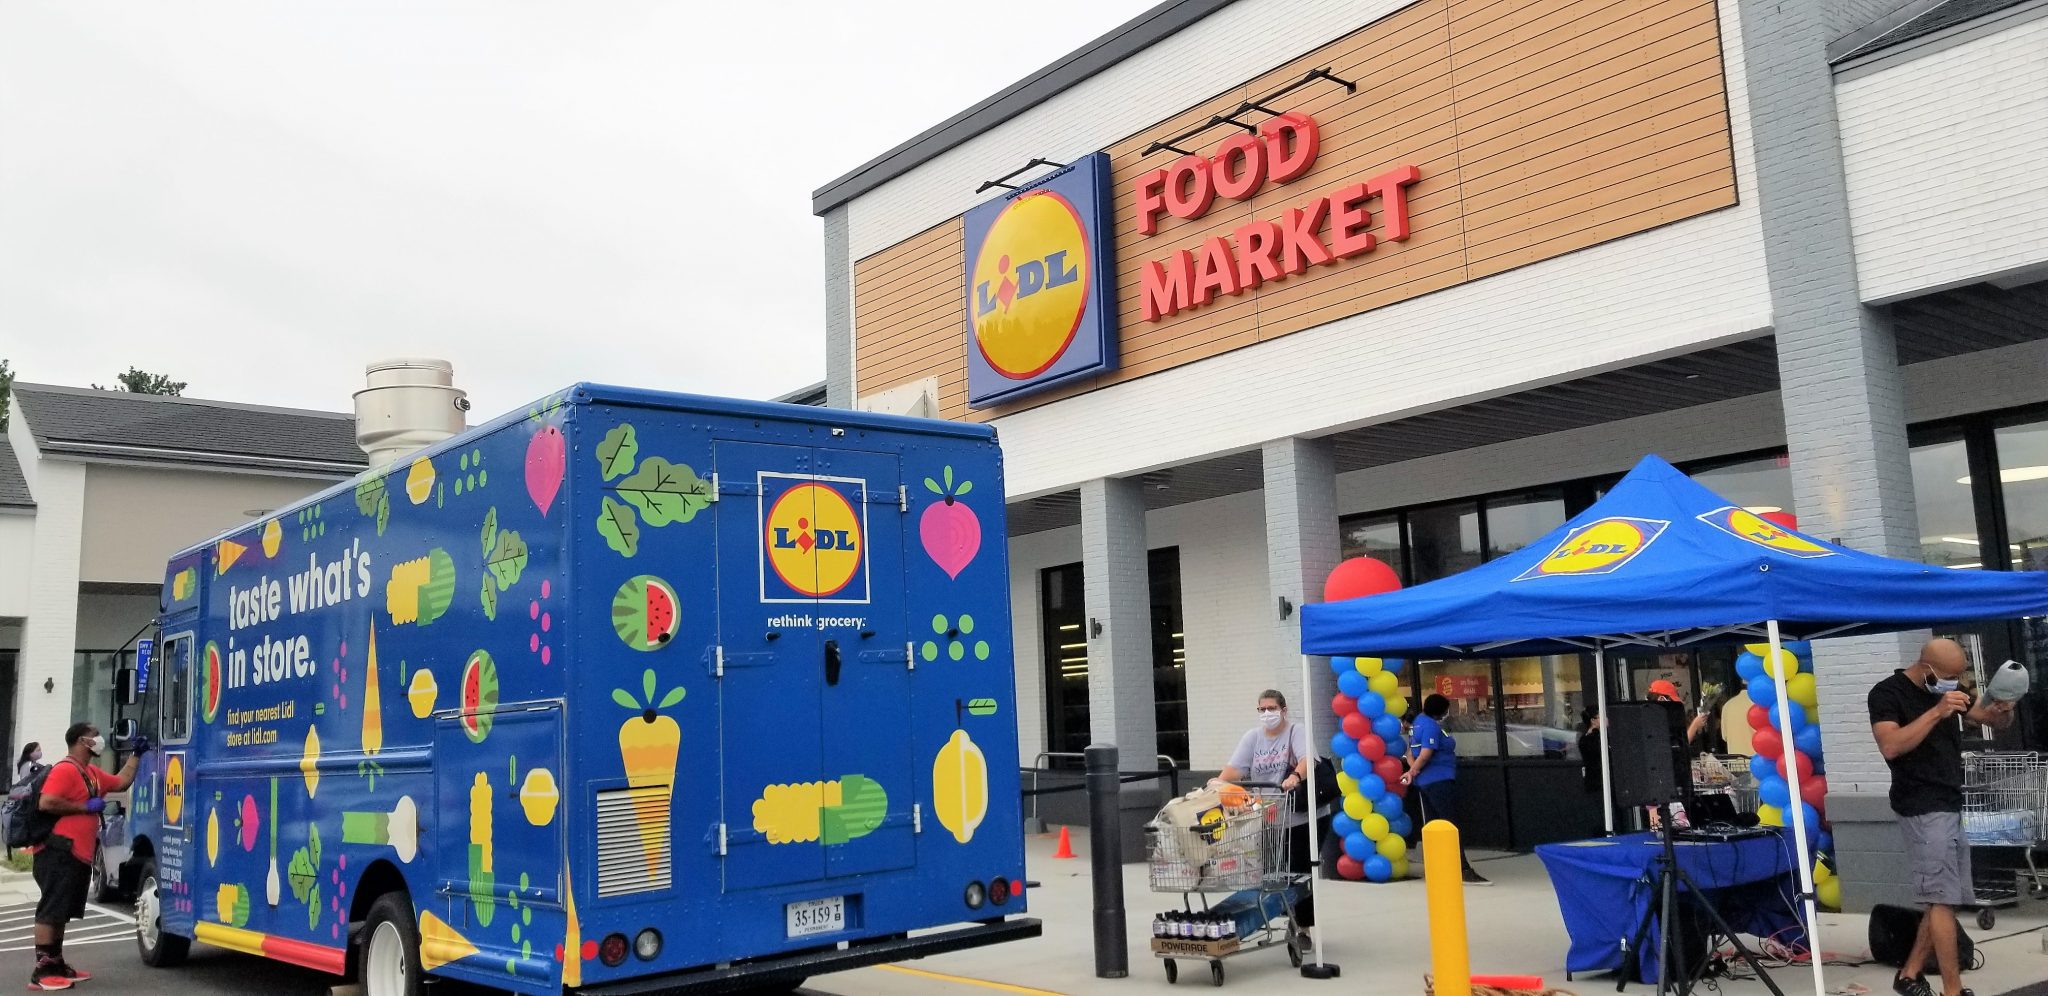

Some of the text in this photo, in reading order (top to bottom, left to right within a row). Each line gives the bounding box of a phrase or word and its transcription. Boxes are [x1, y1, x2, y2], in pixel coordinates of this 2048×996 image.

[1134, 111, 1320, 236] FOOD
[1140, 165, 1421, 323] MARKET
[229, 537, 371, 631] taste what's
[767, 614, 812, 628] rethink
[228, 634, 316, 689] in store.
[227, 700, 294, 729] find your nearest Lidl
[227, 727, 277, 747] store at lidl.com
[1161, 941, 1209, 953] POWERADE
